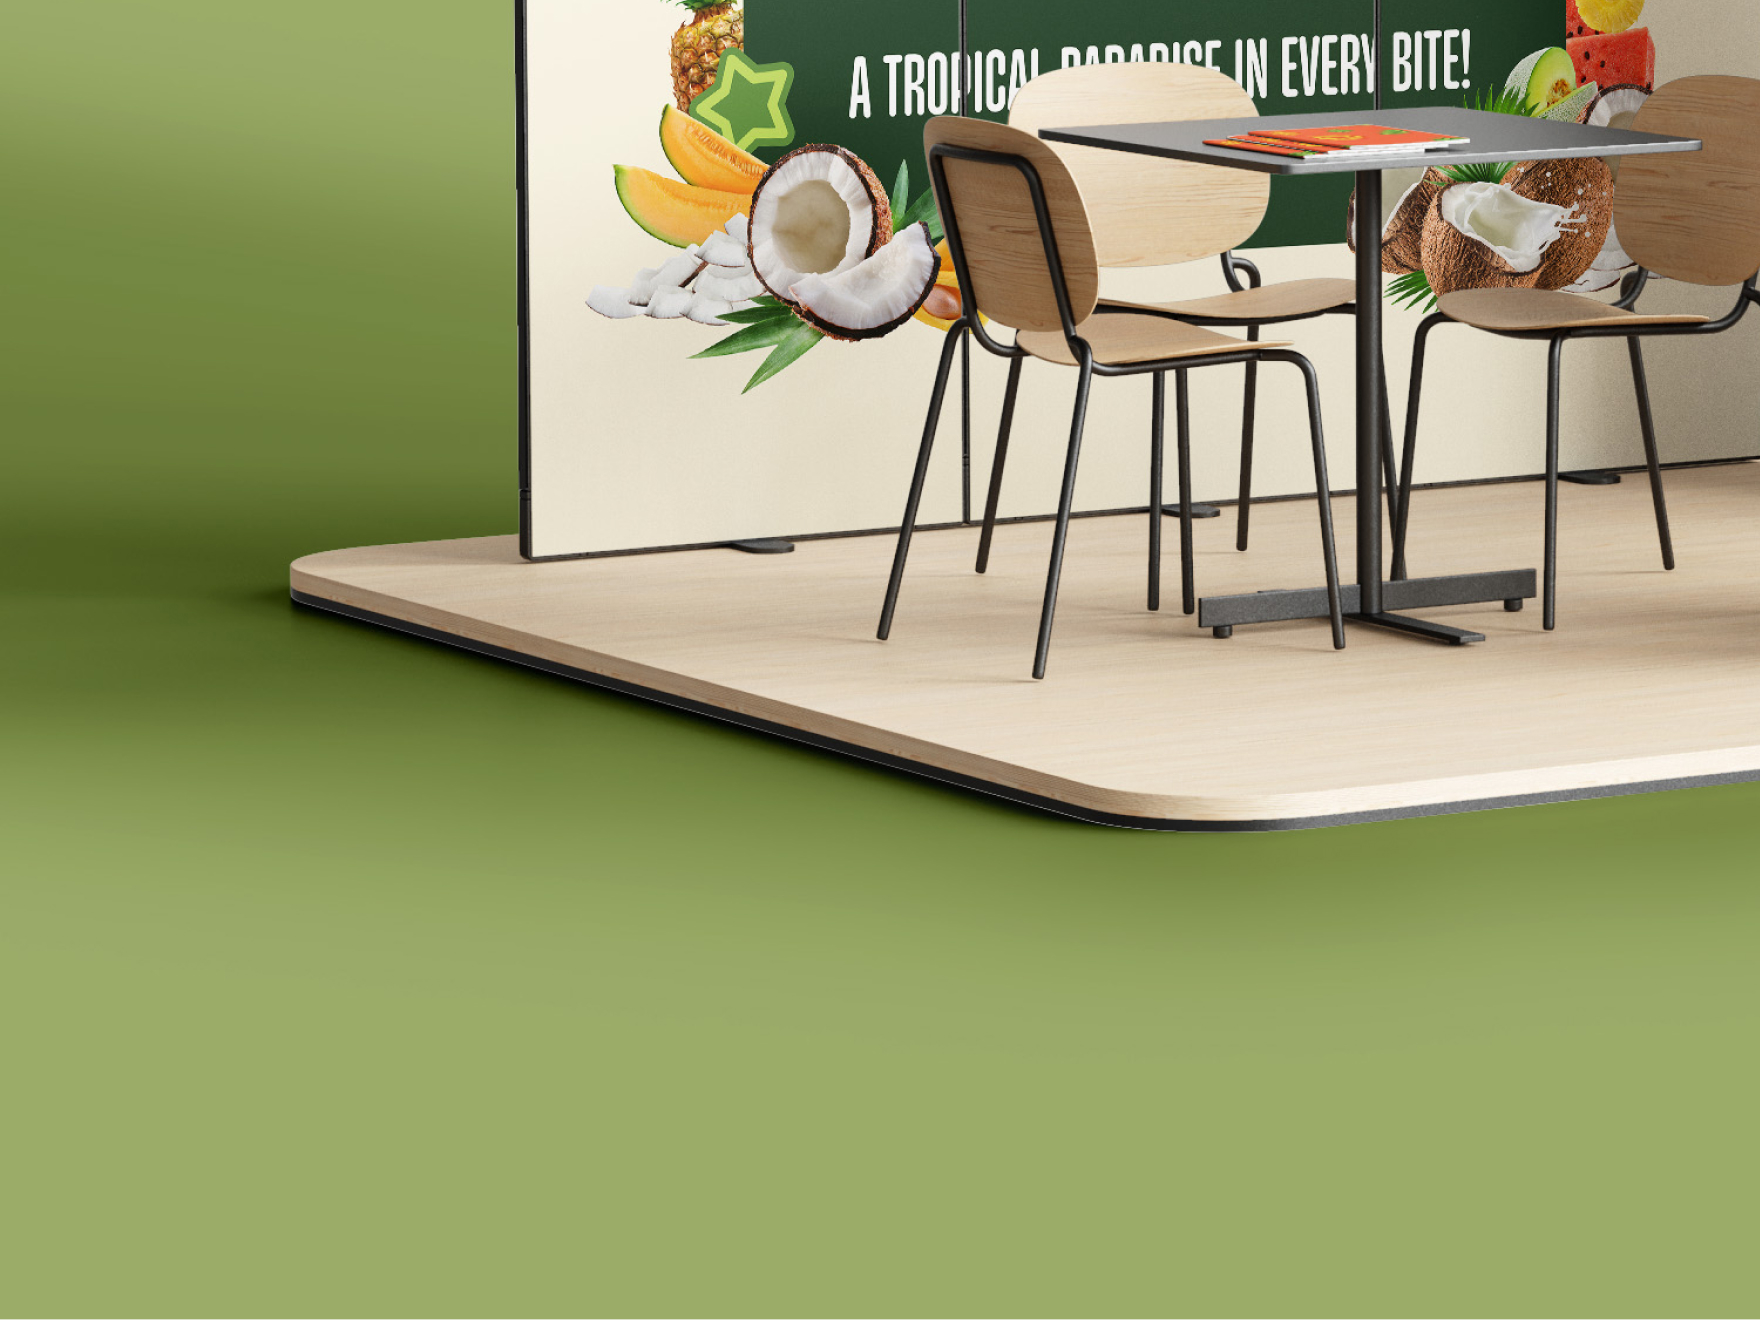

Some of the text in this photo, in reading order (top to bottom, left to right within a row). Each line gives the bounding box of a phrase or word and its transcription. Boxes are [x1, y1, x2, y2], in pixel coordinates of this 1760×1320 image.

[849, 56, 872, 119] A
[1235, 38, 1268, 99] IN
[1282, 33, 1376, 97] EVERY
[1393, 28, 1471, 92] BITE!
